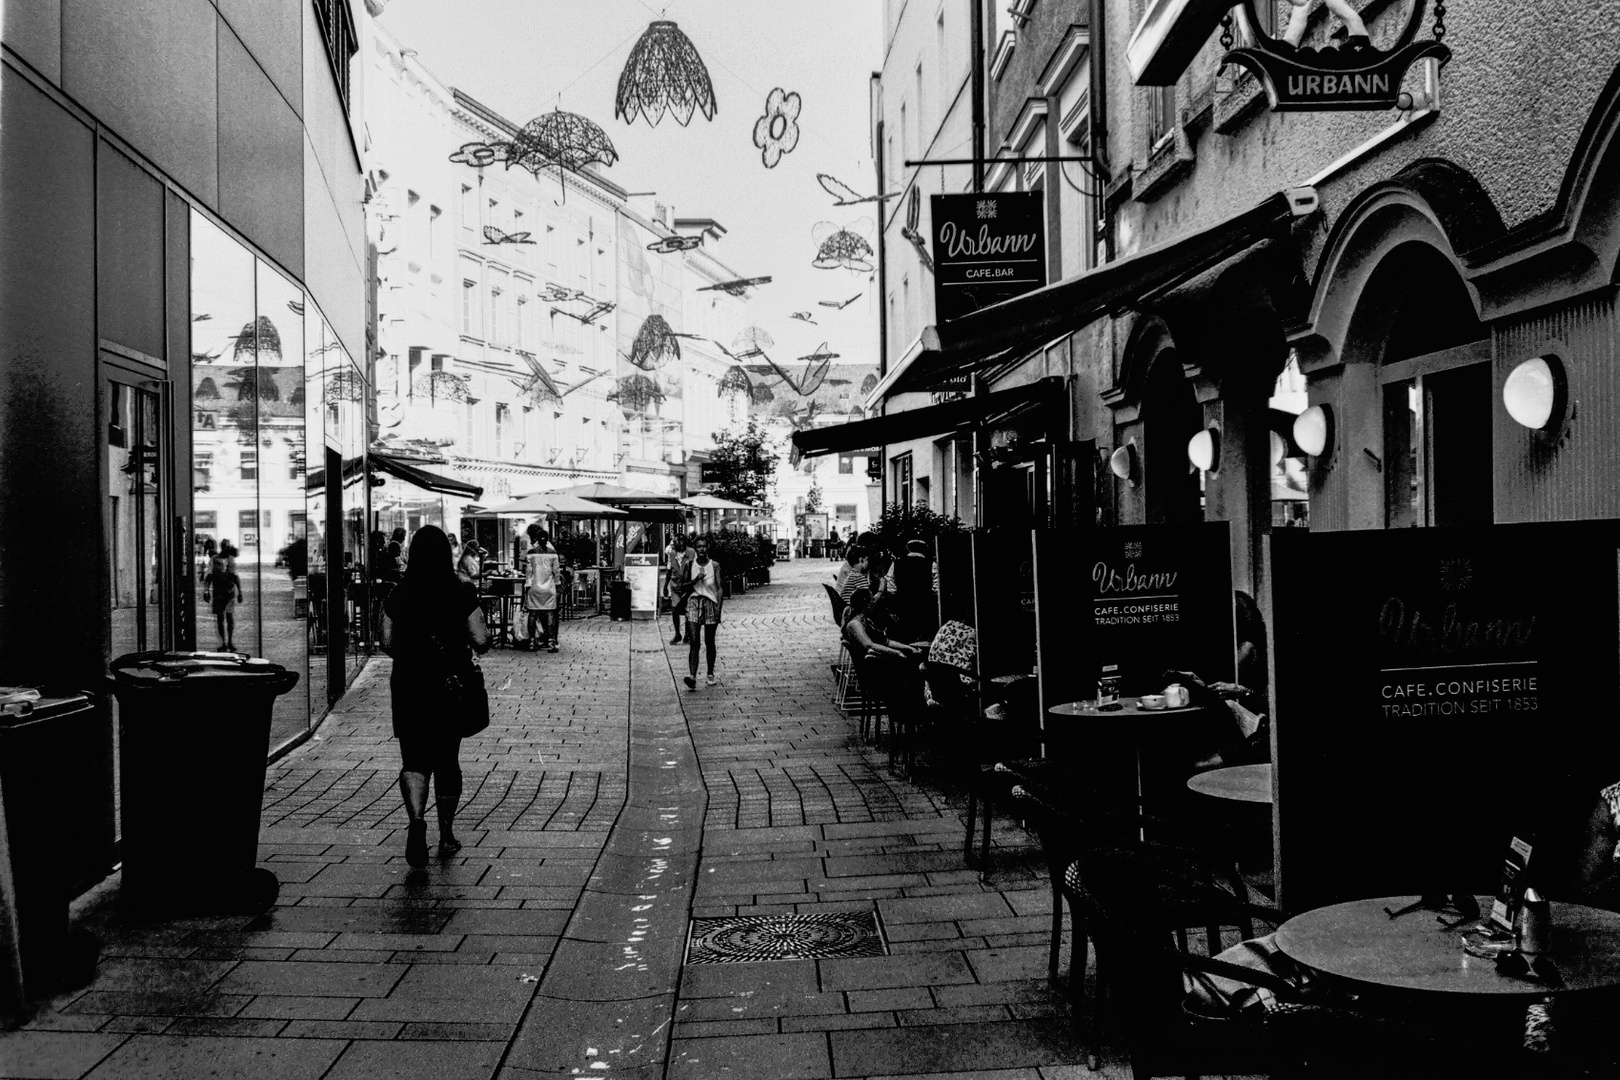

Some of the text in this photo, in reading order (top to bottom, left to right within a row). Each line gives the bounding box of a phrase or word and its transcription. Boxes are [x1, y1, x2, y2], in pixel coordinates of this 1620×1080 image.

[1288, 73, 1389, 95] URBANN
[940, 221, 1037, 258] Urbann
[1092, 561, 1177, 593] Urbann
[1095, 616, 1140, 625] TRADITION
[1142, 614, 1159, 623] SEIT
[1381, 677, 1538, 698] CAFE.CONFISERIE
[1382, 697, 1538, 717] TRADITION SEIT 1853
